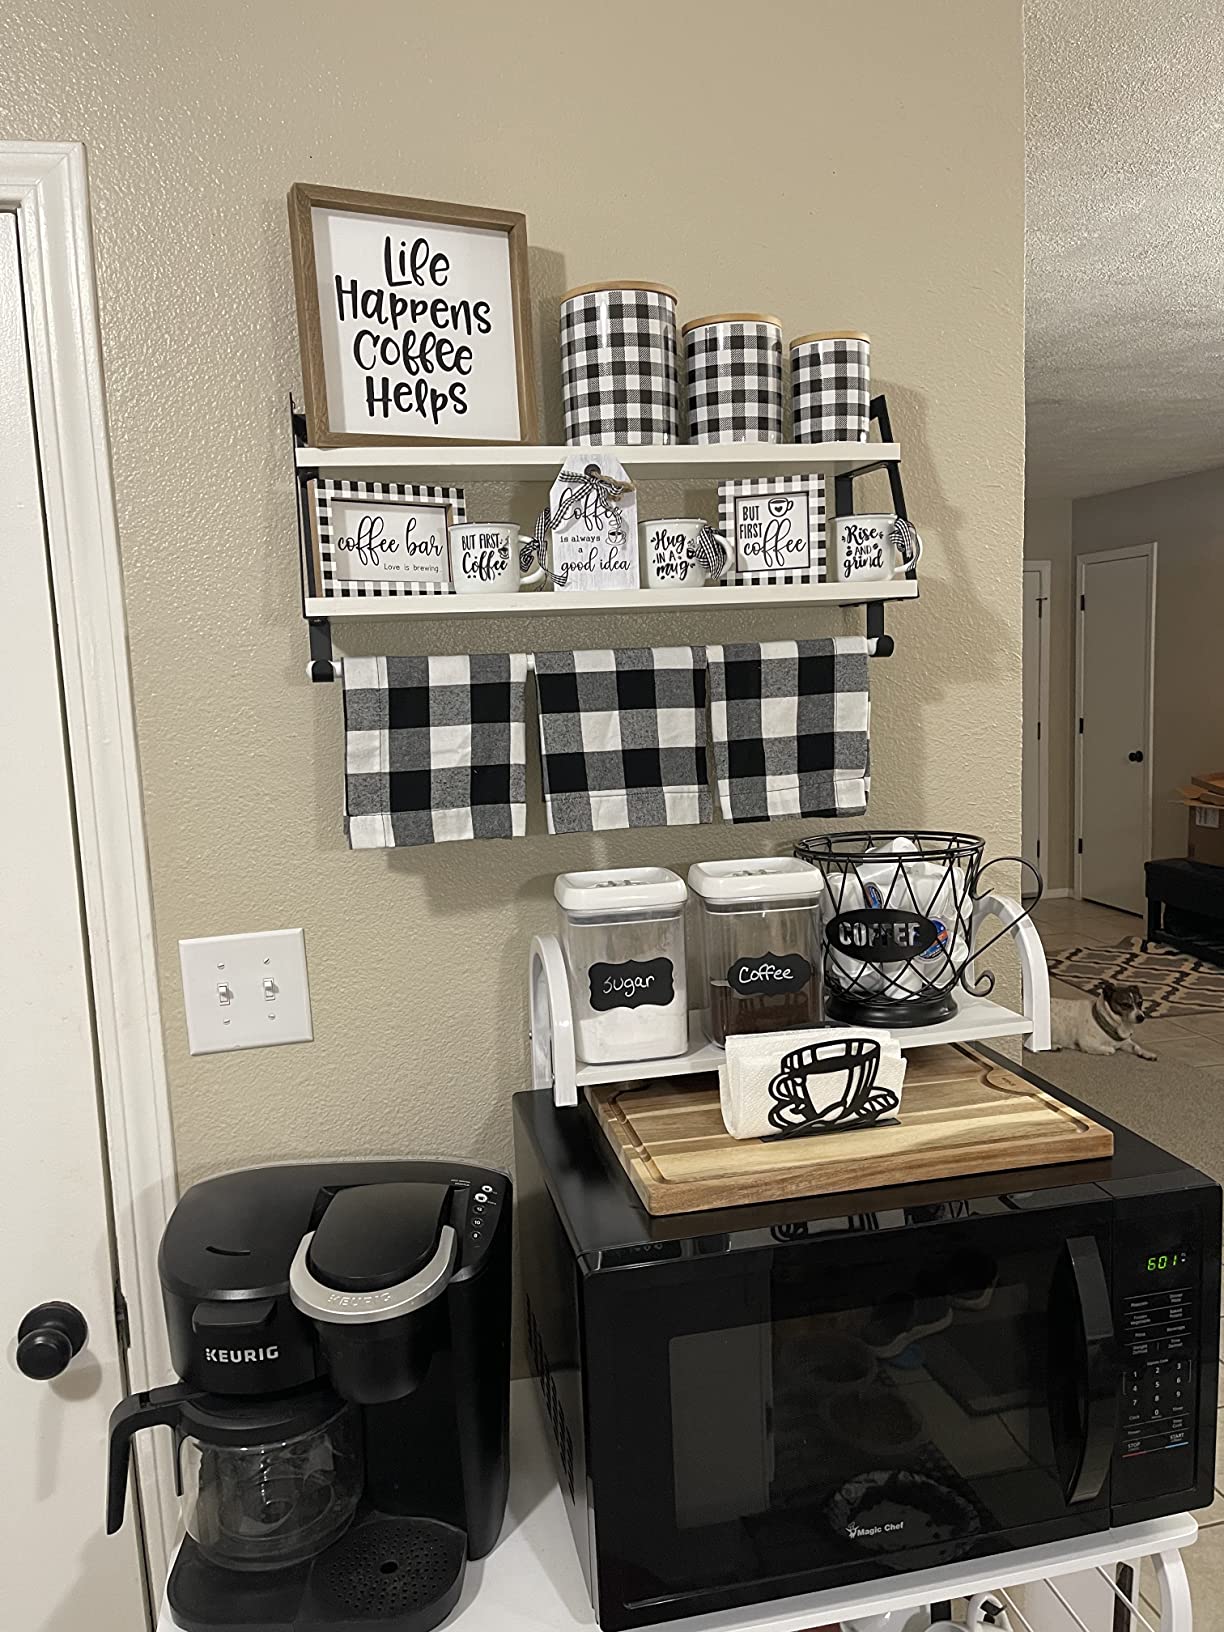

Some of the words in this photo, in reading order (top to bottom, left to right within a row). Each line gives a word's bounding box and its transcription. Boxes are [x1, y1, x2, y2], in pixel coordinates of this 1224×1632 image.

[384, 235, 450, 287] Life
[334, 274, 492, 335] Happens
[353, 329, 473, 376] Coffee
[365, 375, 468, 425] Helps
[742, 505, 760, 521] BUT
[337, 515, 400, 566] coffee
[405, 517, 443, 556] bar
[560, 535, 568, 543] is
[571, 535, 600, 543] always
[739, 523, 762, 539] FIRST
[844, 524, 879, 545] Rise
[461, 534, 476, 551] BUT
[479, 533, 500, 549] FIRST
[655, 529, 686, 554] Hug
[743, 518, 807, 567] coffee
[855, 545, 872, 556] AND
[462, 550, 508, 581] Coffee
[560, 546, 598, 579] good
[599, 546, 630, 572] idea
[656, 552, 666, 564] IN
[669, 550, 677, 562] A
[843, 548, 884, 578] grind
[383, 563, 401, 571] Love
[404, 563, 410, 571] is
[413, 563, 439, 573] brewing
[656, 561, 689, 581] mug
[738, 963, 794, 984] Coffee
[205, 1345, 279, 1363] KEURIG
[1155, 1366, 1160, 1374] 2
[1176, 1362, 1181, 1370] 3
[857, 1526, 882, 1537] Magic
[884, 1521, 904, 1532] Chef
